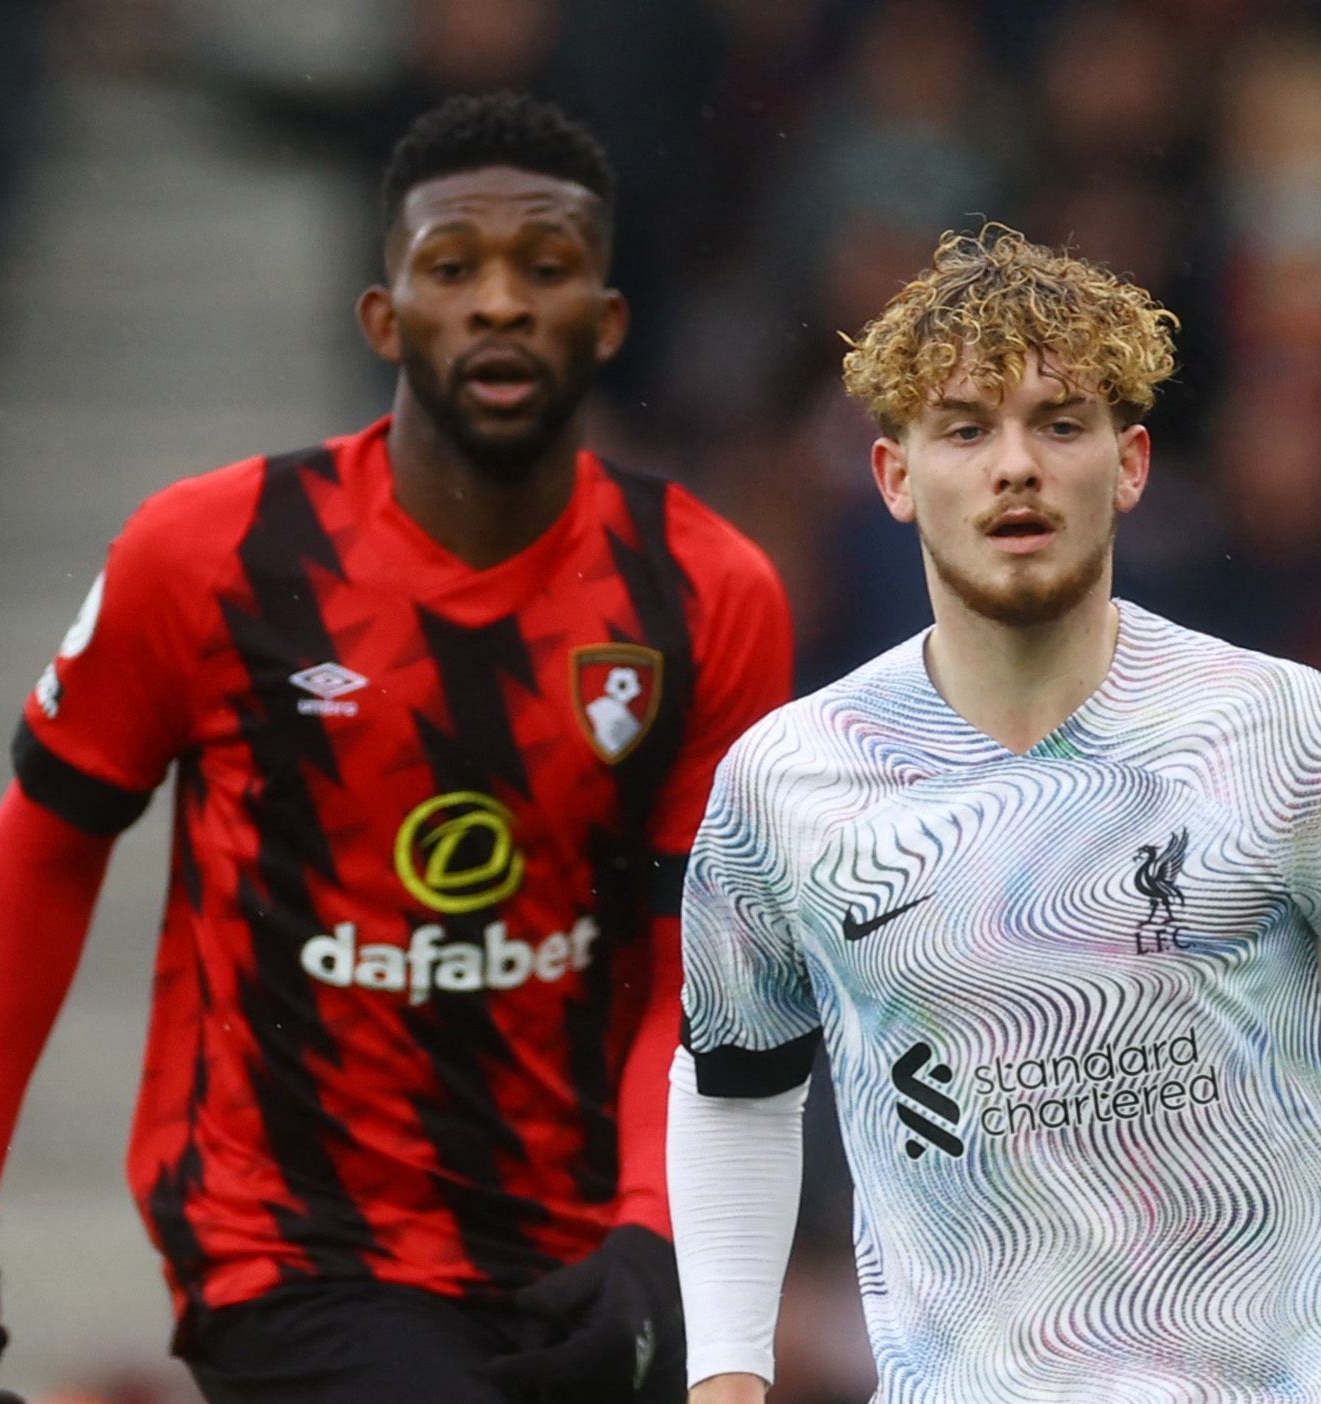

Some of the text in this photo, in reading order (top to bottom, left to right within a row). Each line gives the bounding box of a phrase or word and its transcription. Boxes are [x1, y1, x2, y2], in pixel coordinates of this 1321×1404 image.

[300, 920, 600, 1006] dafabet
[974, 1027, 1200, 1096] standard
[981, 1065, 1221, 1137] chartered
